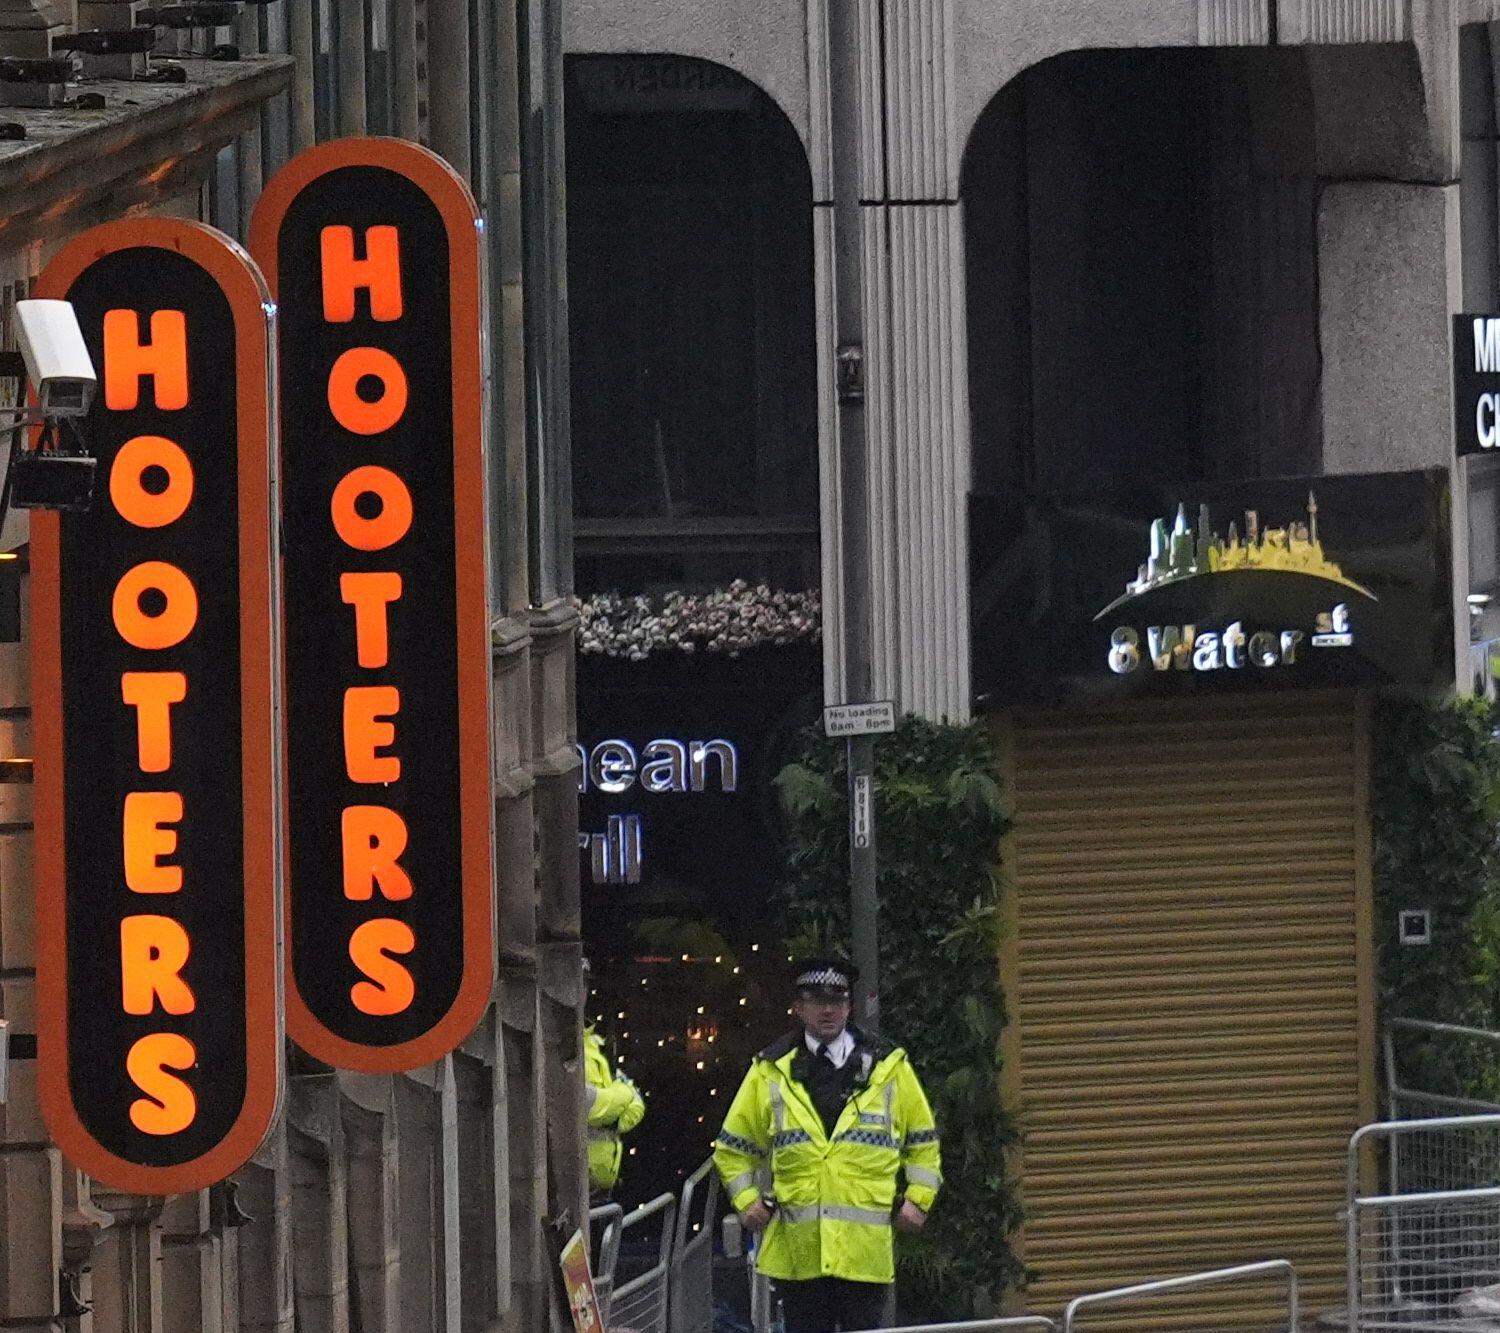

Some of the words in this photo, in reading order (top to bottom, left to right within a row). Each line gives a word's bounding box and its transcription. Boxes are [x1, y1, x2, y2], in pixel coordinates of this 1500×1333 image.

[103, 308, 198, 1137] HOOTERS
[320, 225, 415, 1016] HOOTERS
[1108, 626, 1141, 674] 8
[1147, 621, 1303, 671] Water
[1315, 603, 1349, 633] st
[578, 813, 642, 883] ill
